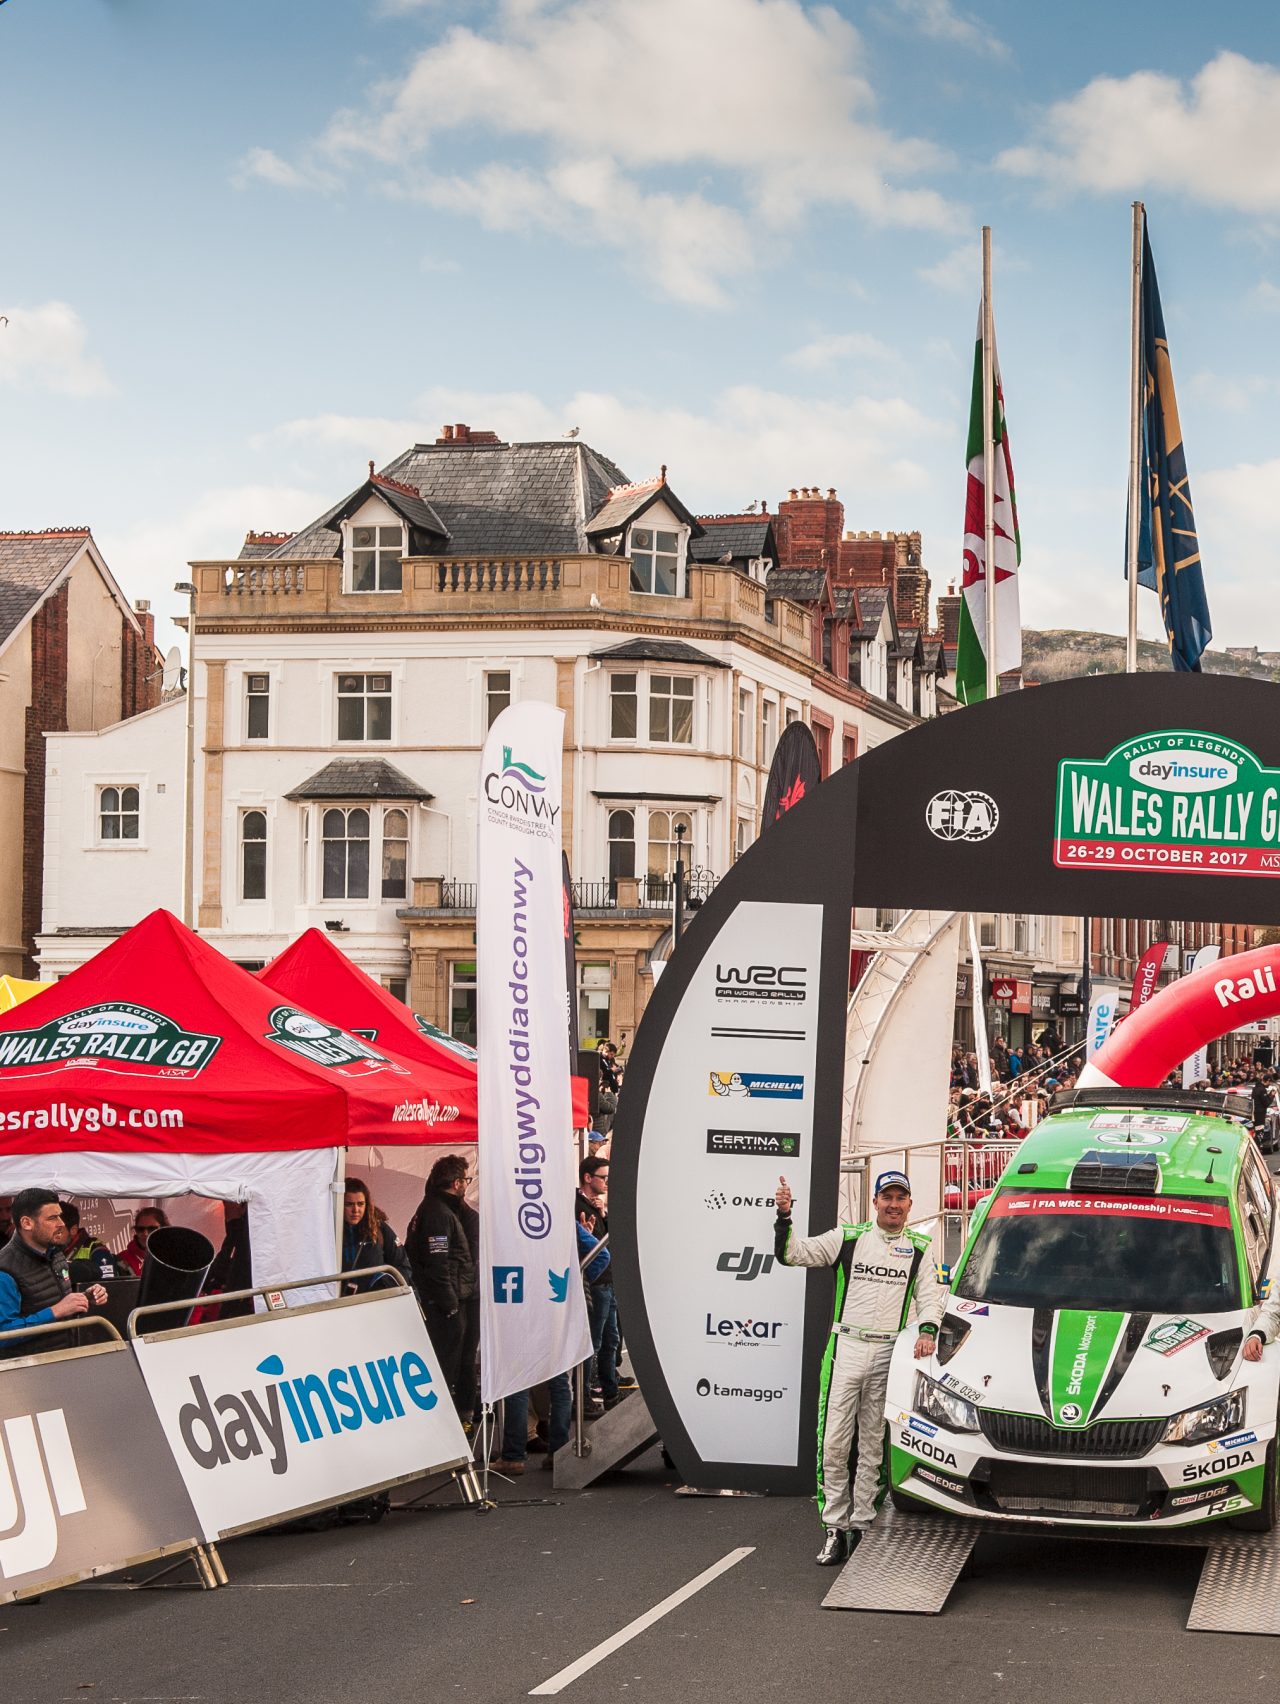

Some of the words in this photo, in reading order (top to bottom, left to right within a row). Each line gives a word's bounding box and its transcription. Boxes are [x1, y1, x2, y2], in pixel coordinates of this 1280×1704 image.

[1123, 739, 1161, 760] RALLY
[1167, 738, 1184, 747] OF
[1190, 739, 1245, 766] LEGENDS
[1139, 761, 1228, 780] dayinsure
[485, 772, 560, 825] CONWY
[1071, 770, 1163, 837] WALES
[1172, 791, 1254, 841] RALLY
[488, 815, 508, 828] COUNTY
[1067, 845, 1115, 860] 26-29
[1121, 847, 1203, 864] OCTOBER
[1209, 852, 1248, 865] 2017
[716, 964, 807, 987] WRC
[734, 990, 768, 998] WORLD
[1214, 966, 1276, 1008] Rali
[717, 998, 804, 1006] CHAMPIONSHIP
[57, 1008, 94, 1026] RALLY
[119, 1006, 168, 1027] LEGENDS
[67, 1017, 149, 1031] dayinsure
[0, 1035, 82, 1066] WALES
[81, 1034, 168, 1063] RALLY
[166, 1039, 209, 1067] GB
[750, 1081, 804, 1091] MICHELIN
[712, 1134, 780, 1147] CERTINA
[732, 1195, 798, 1210] ONEBT
[1038, 1200, 1056, 1208] FIA
[1058, 1200, 1081, 1208] WRC
[1094, 1201, 1166, 1213] Championship
[854, 1262, 907, 1279] ŠKODA
[706, 1313, 782, 1338] Lexar
[1066, 1352, 1088, 1395] ŠKODA
[1077, 1315, 1097, 1351] Motorsport
[714, 1383, 783, 1402] tamaggo
[960, 1385, 981, 1402] 0329
[179, 1349, 439, 1475] dayinsure
[900, 1429, 958, 1469] ŠKODA
[1224, 1433, 1256, 1447] MICHELIN
[1182, 1450, 1255, 1482] ŠKODA
[935, 1475, 964, 1493] EDGE
[1198, 1485, 1230, 1501] EDGE
[1207, 1495, 1243, 1515] R5
